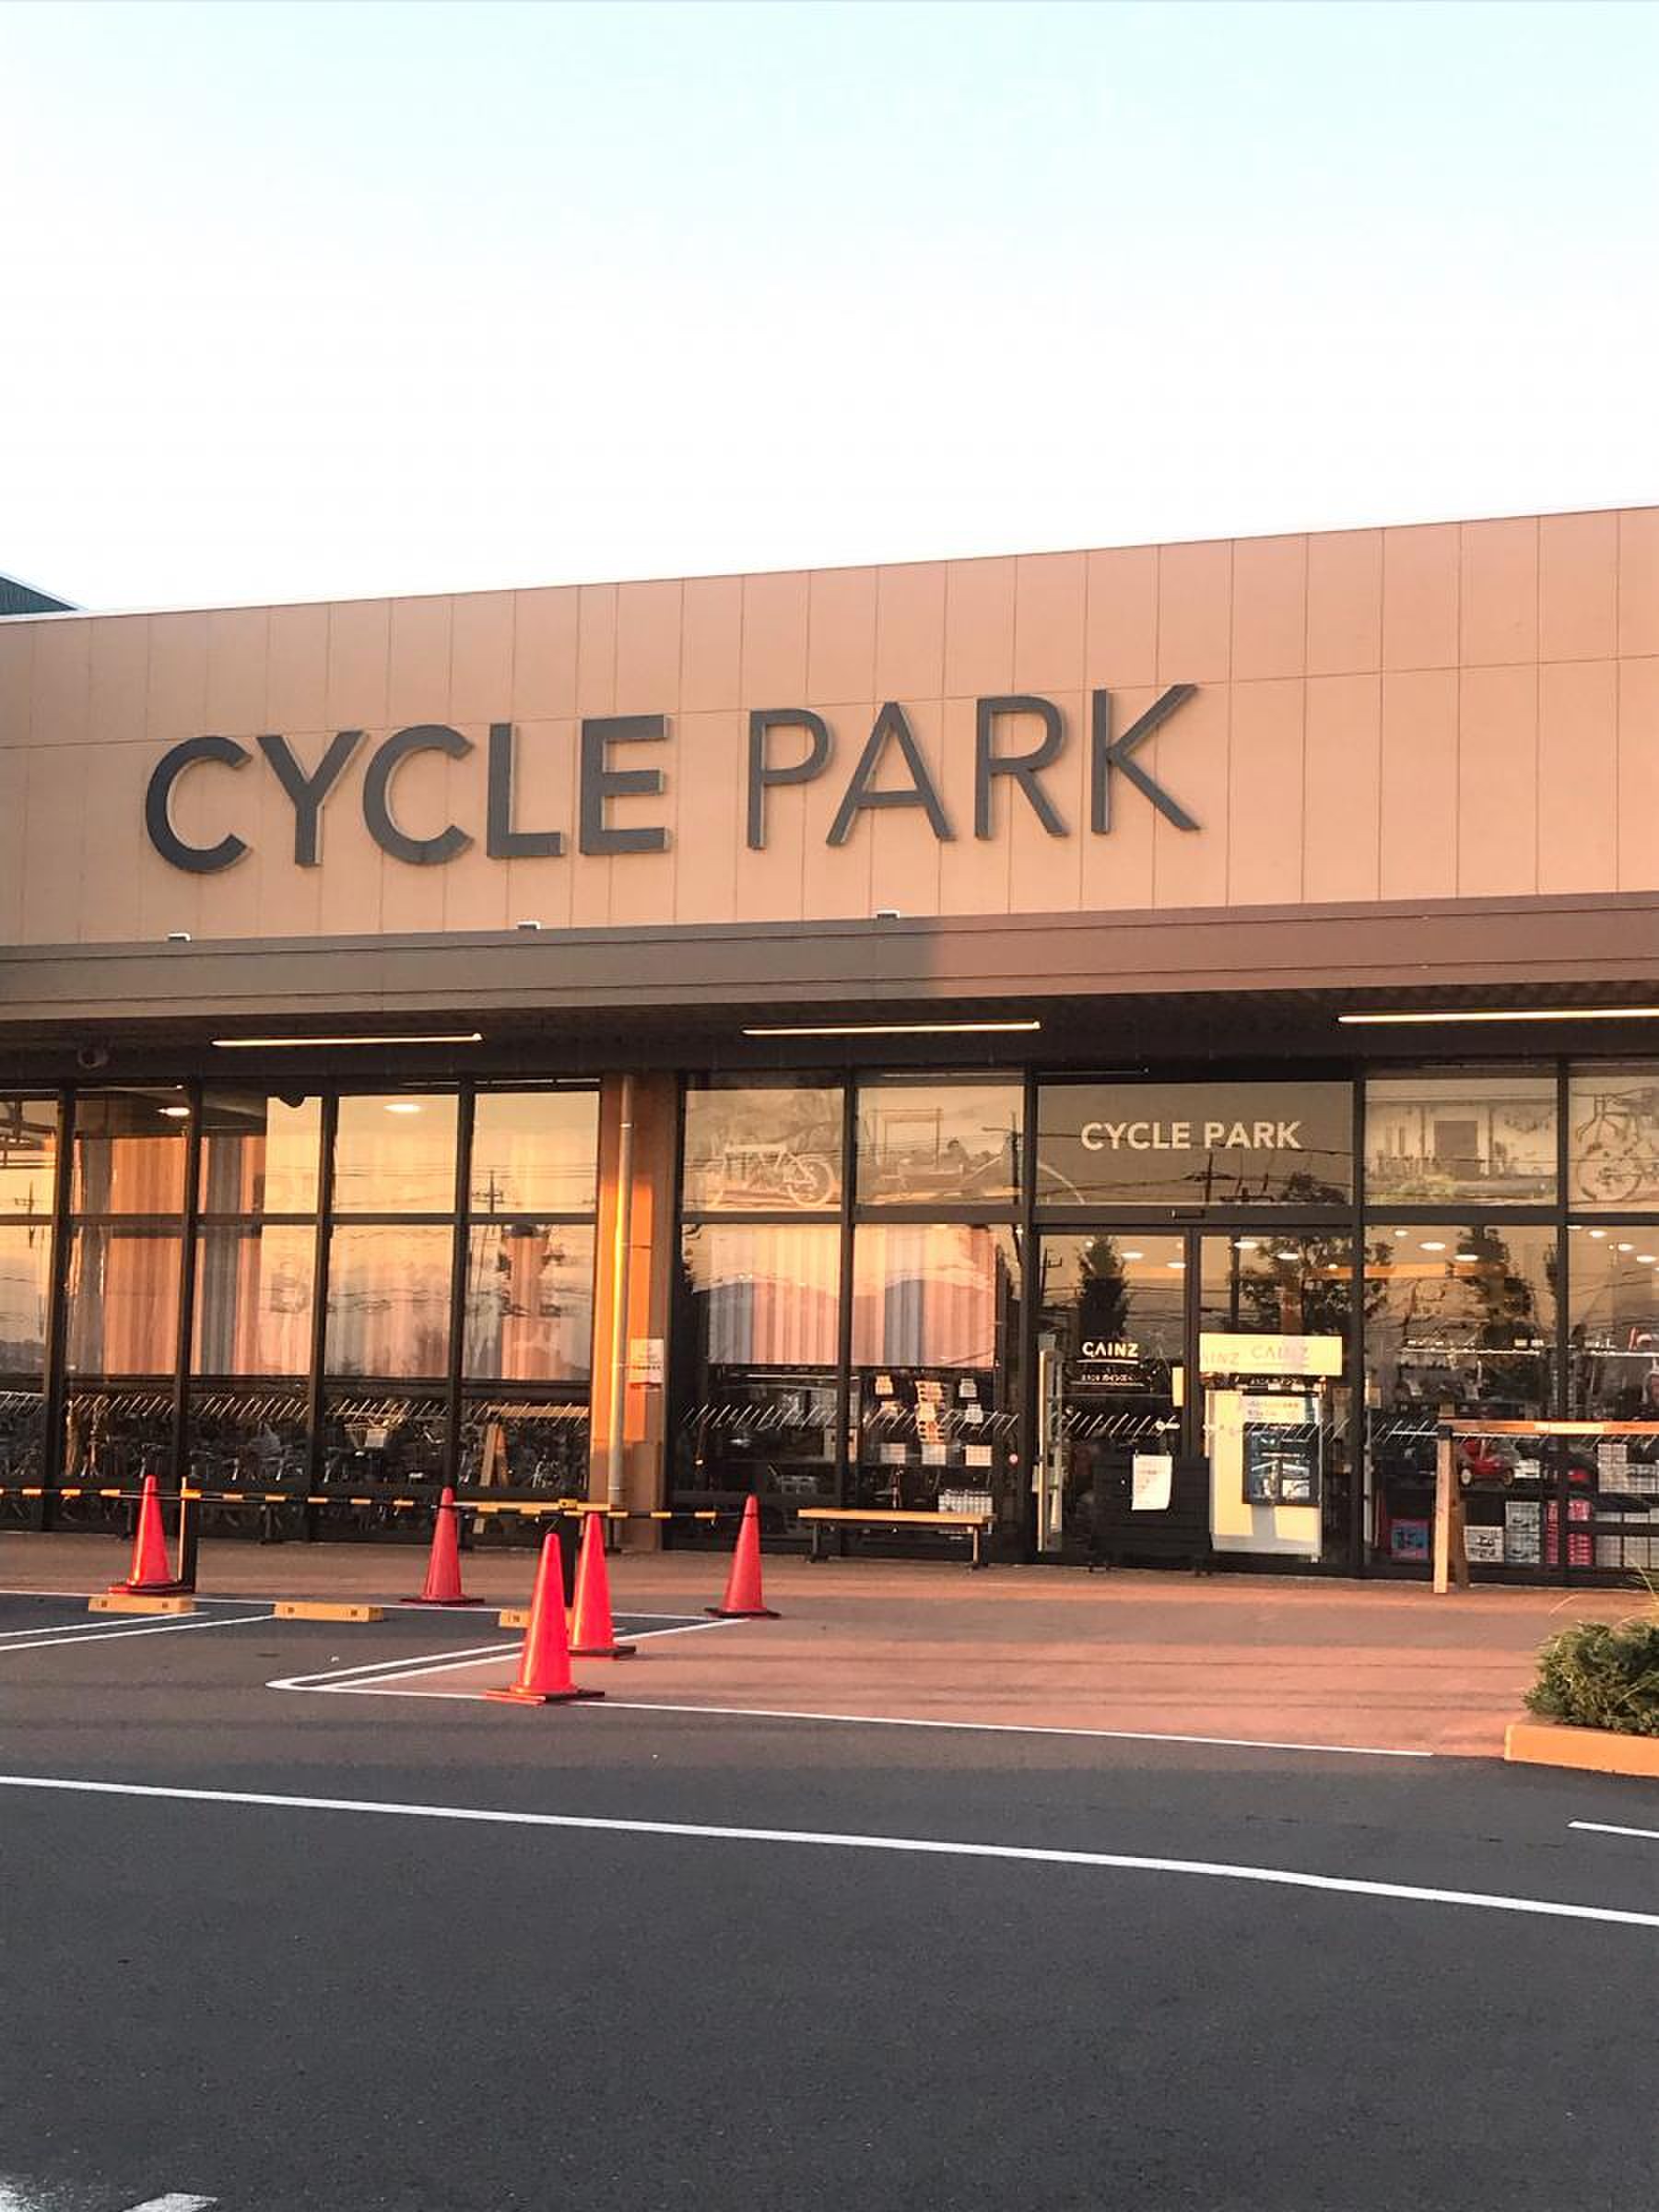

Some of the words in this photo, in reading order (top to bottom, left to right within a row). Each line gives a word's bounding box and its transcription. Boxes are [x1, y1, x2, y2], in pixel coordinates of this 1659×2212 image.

[146, 714, 671, 874] CYCLE
[747, 683, 1201, 850] PARK
[1081, 1122, 1192, 1150] CYCLE
[1204, 1121, 1302, 1150] PARK
[1082, 1341, 1139, 1358] CAINZ
